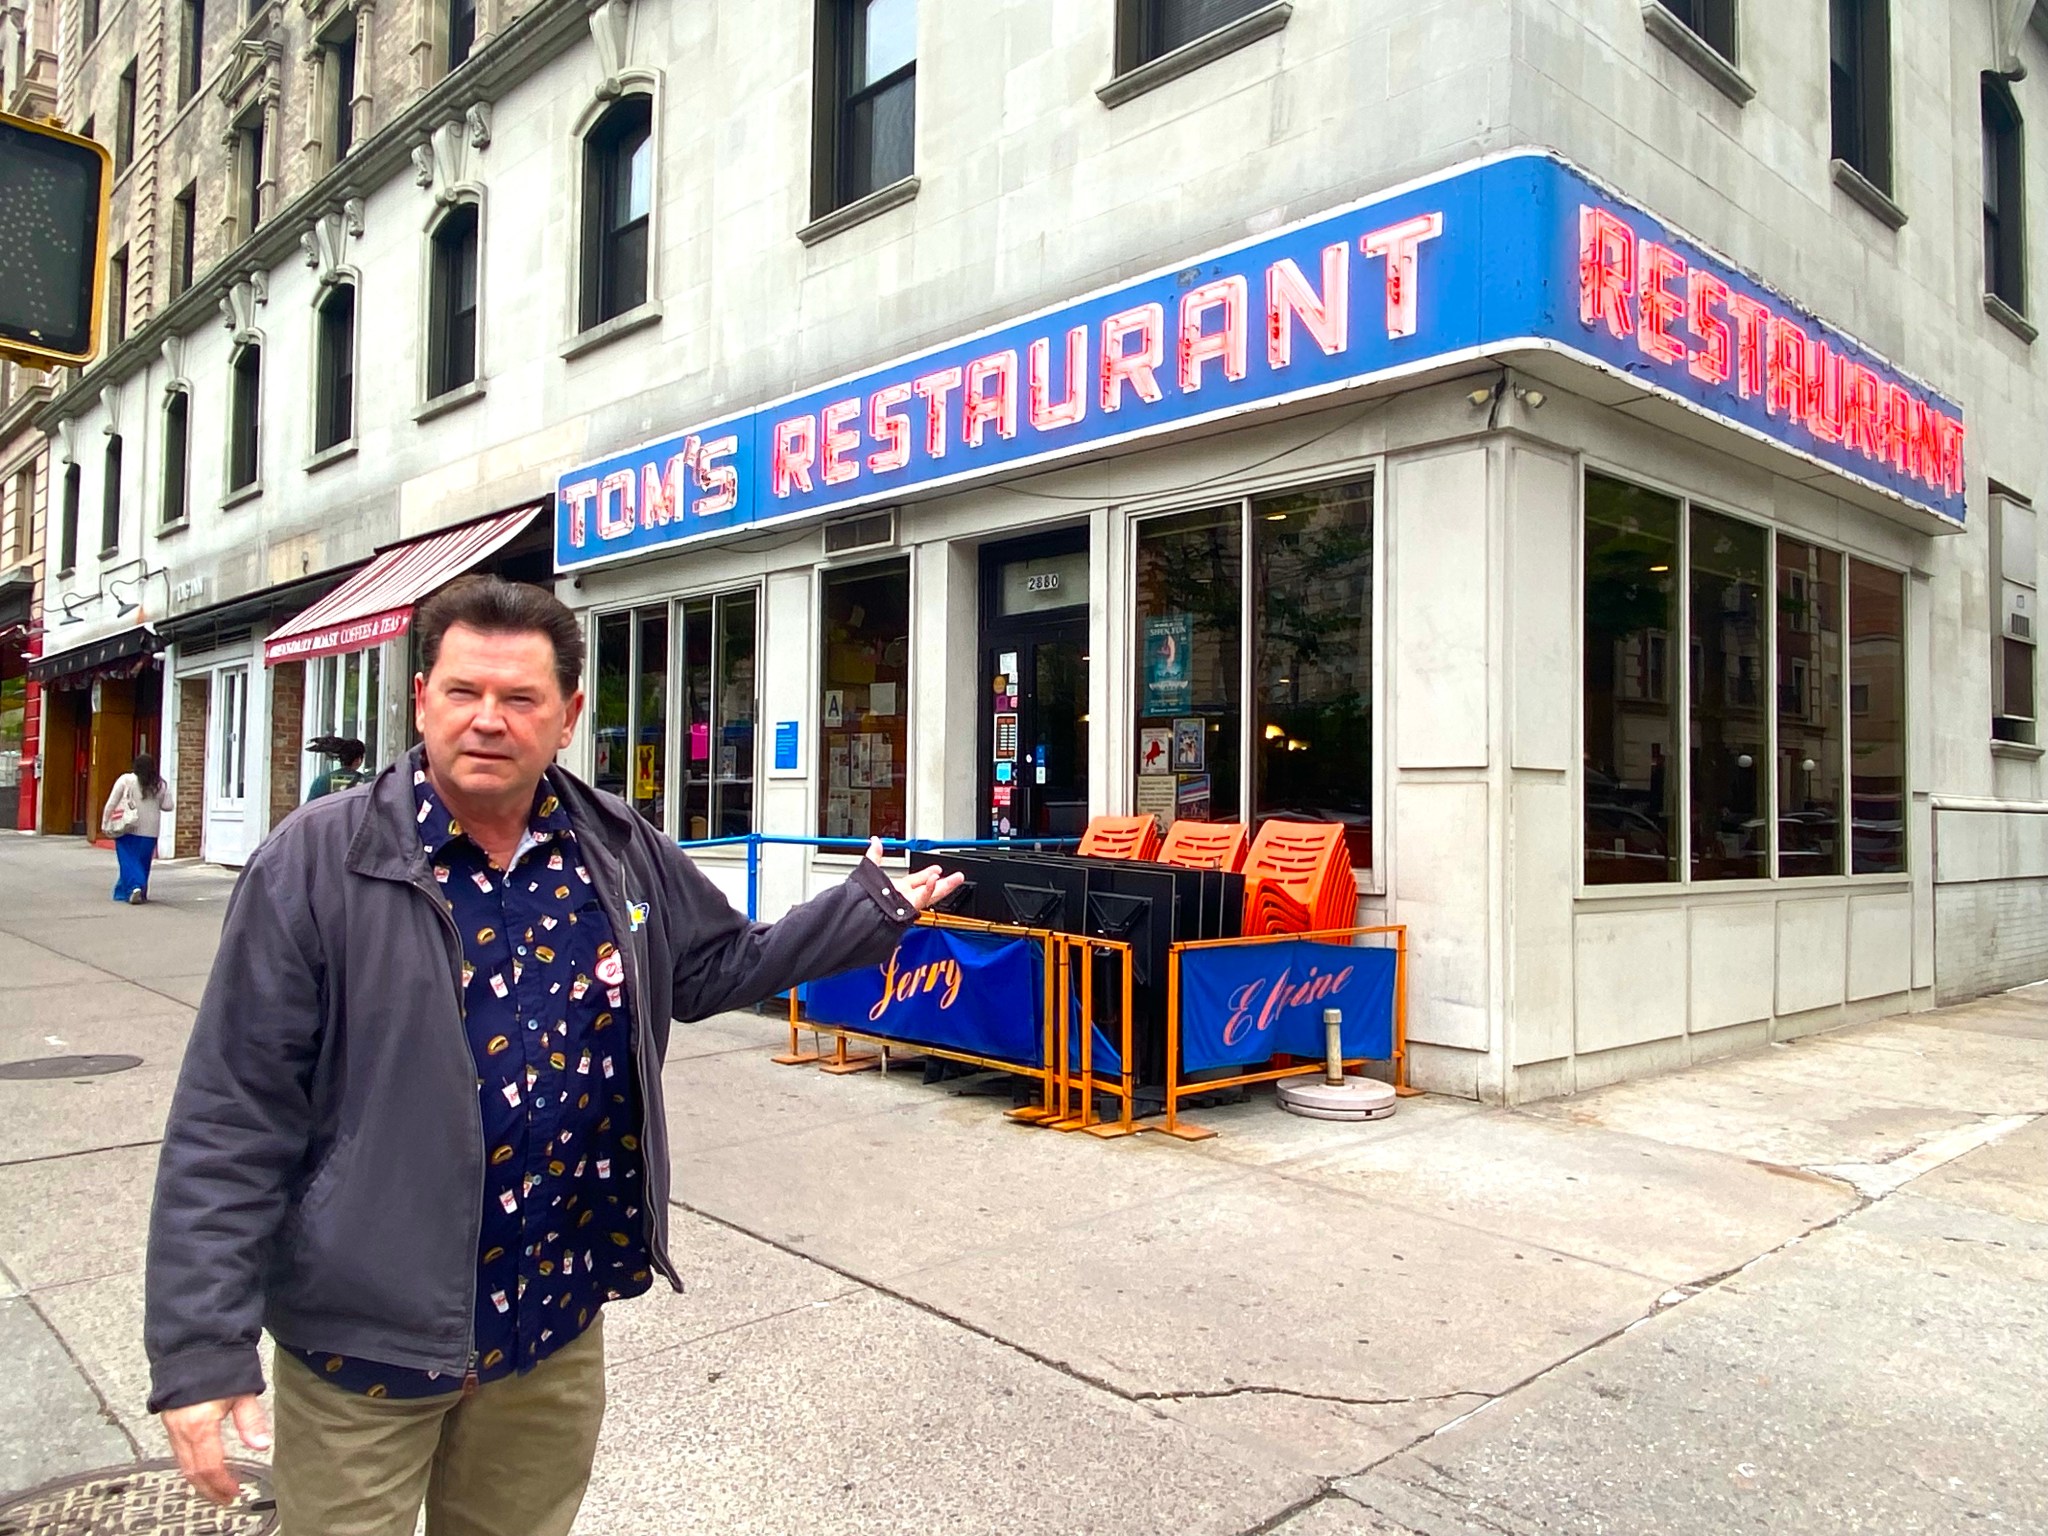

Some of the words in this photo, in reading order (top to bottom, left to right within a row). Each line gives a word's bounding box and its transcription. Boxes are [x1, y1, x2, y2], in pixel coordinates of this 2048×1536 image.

[1579, 204, 1967, 499] RESTAURANT
[562, 434, 738, 548] TOM'S
[773, 211, 1443, 499] RESTAURANT
[1029, 574, 1058, 590] 2880
[340, 622, 372, 643] COFFEES
[380, 615, 402, 634] TEAS
[828, 695, 840, 717] A
[869, 945, 963, 1021] Jerry
